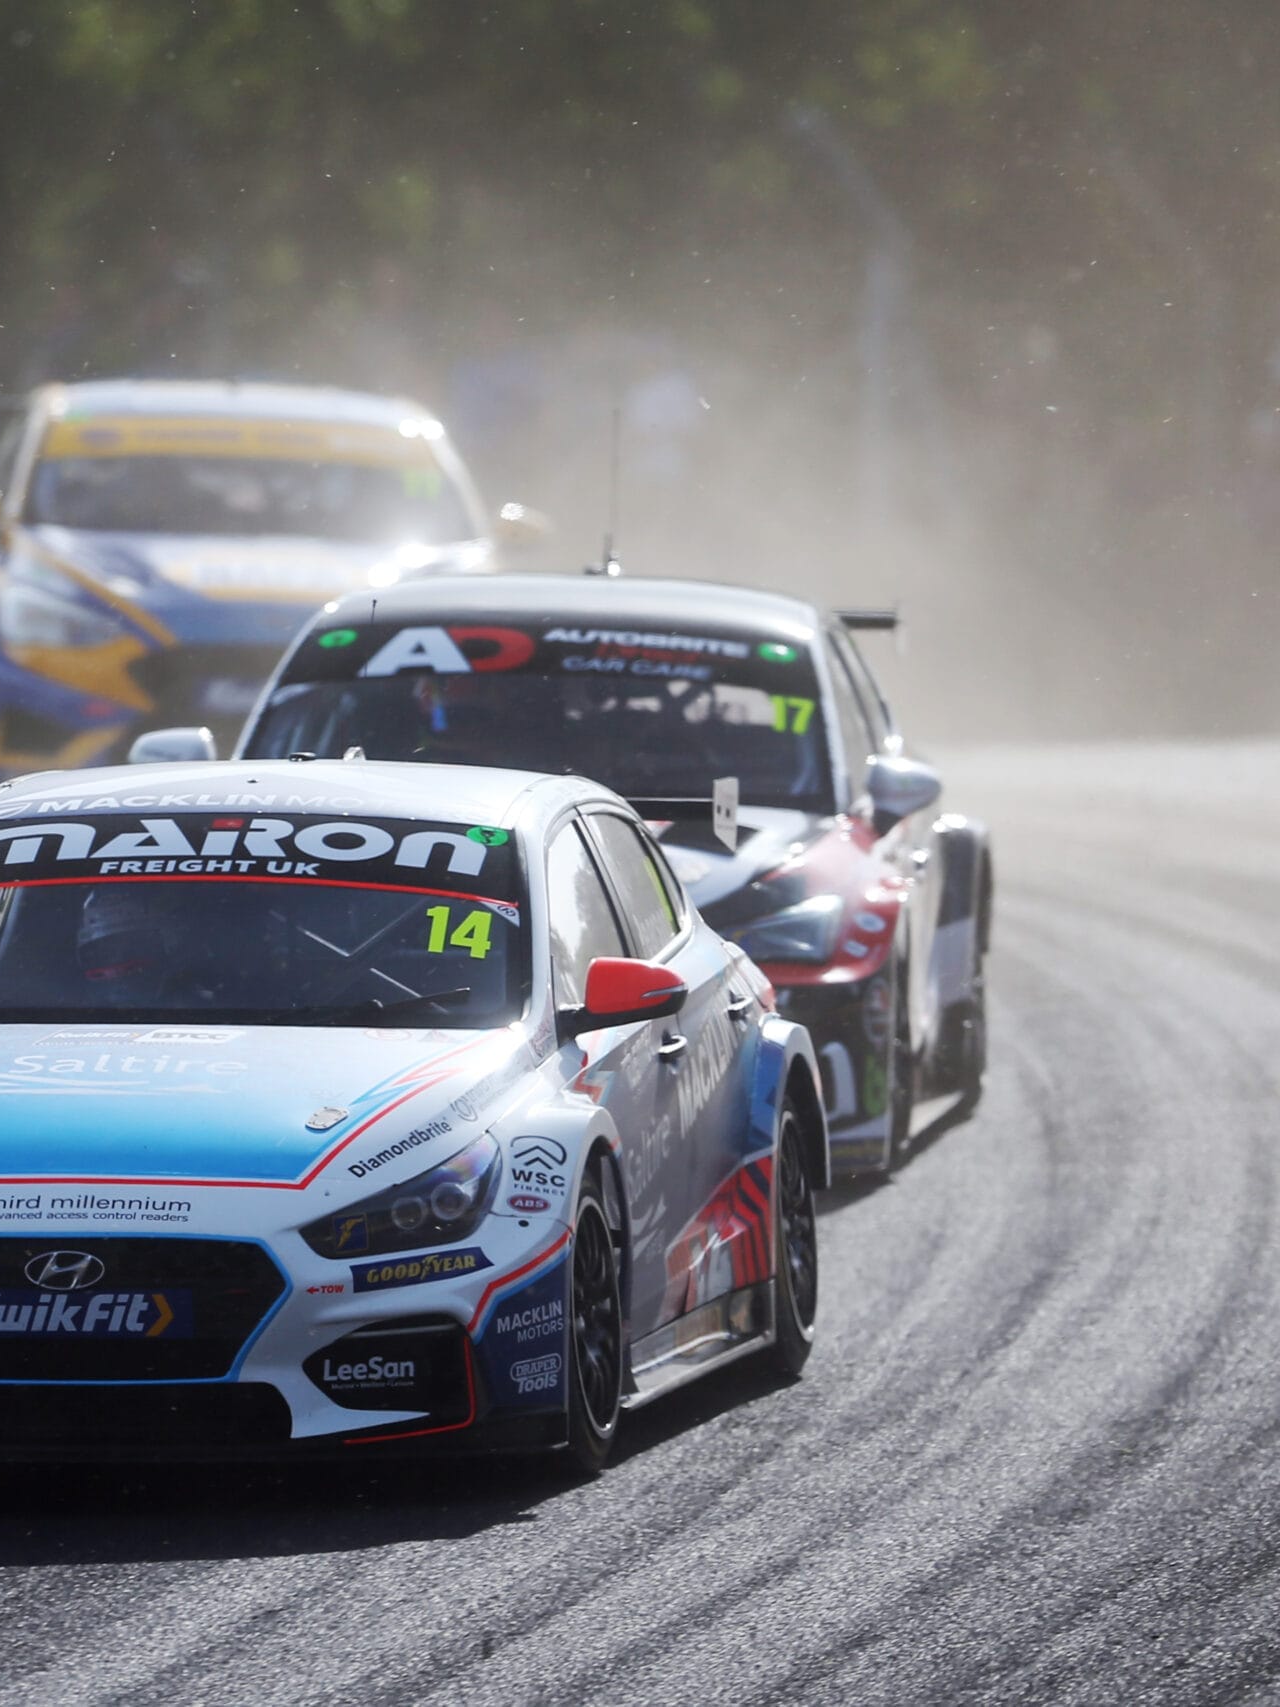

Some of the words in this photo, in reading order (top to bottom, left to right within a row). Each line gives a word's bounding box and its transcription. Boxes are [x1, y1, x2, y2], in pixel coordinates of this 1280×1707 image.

[543, 628, 751, 658] AUTOBRITE
[561, 656, 625, 672] CAR
[770, 695, 815, 735] 17
[38, 793, 278, 814] MACKLIN
[98, 859, 258, 875] FREIGHT
[264, 860, 321, 876] UK
[426, 905, 493, 960] 14
[9, 1053, 249, 1076] Saltire
[347, 1121, 453, 1179] Diamondbrite
[511, 1168, 566, 1188] WSC
[512, 1184, 566, 1197] FINANCE
[50, 1195, 192, 1212] millennium
[513, 1199, 545, 1209] ABS
[46, 1212, 89, 1220] access
[92, 1211, 137, 1221] control
[140, 1212, 190, 1222] readers
[366, 1253, 477, 1284] GOODYEAR
[320, 1285, 345, 1295] TOW
[496, 1300, 563, 1334] MACKLIN
[516, 1318, 565, 1344] MOTORS
[322, 1356, 416, 1382] LeeSan
[514, 1358, 558, 1377] DRAPER
[517, 1374, 559, 1395] Tools
